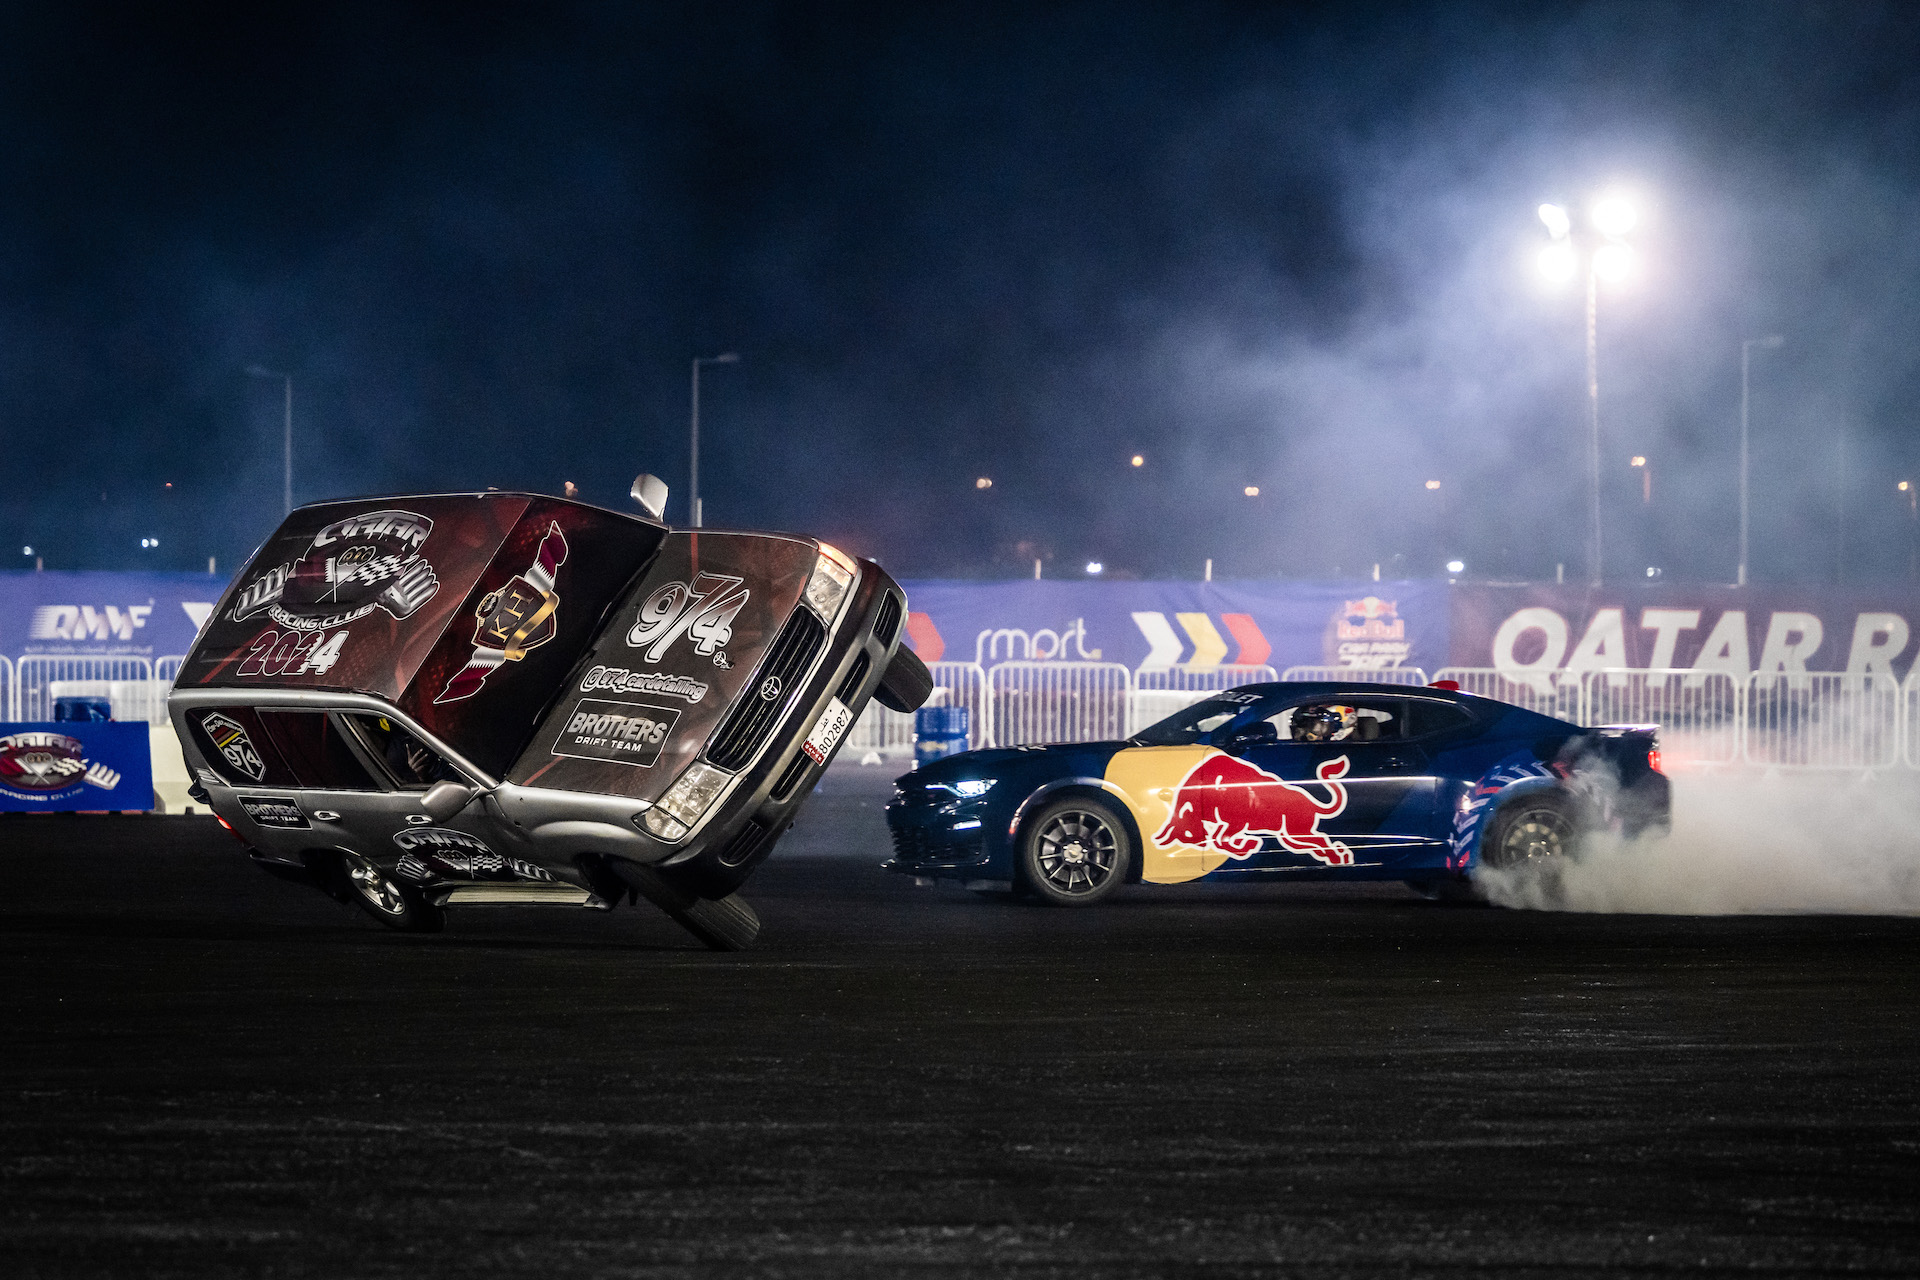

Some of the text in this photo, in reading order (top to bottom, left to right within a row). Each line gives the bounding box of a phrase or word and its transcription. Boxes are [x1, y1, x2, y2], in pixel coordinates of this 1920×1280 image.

[315, 514, 428, 548] QATAR
[270, 603, 374, 629] RACING CLUB
[488, 590, 534, 643] KH
[626, 570, 750, 663] 974
[237, 630, 349, 676] 2024
[1492, 607, 1920, 695] QATAR R
[567, 713, 667, 744] BROTHERS
[575, 735, 642, 752] DRIFT TEAM
[819, 709, 848, 754] 802887
[224, 744, 262, 774] 974
[244, 804, 302, 816] BROTHERS
